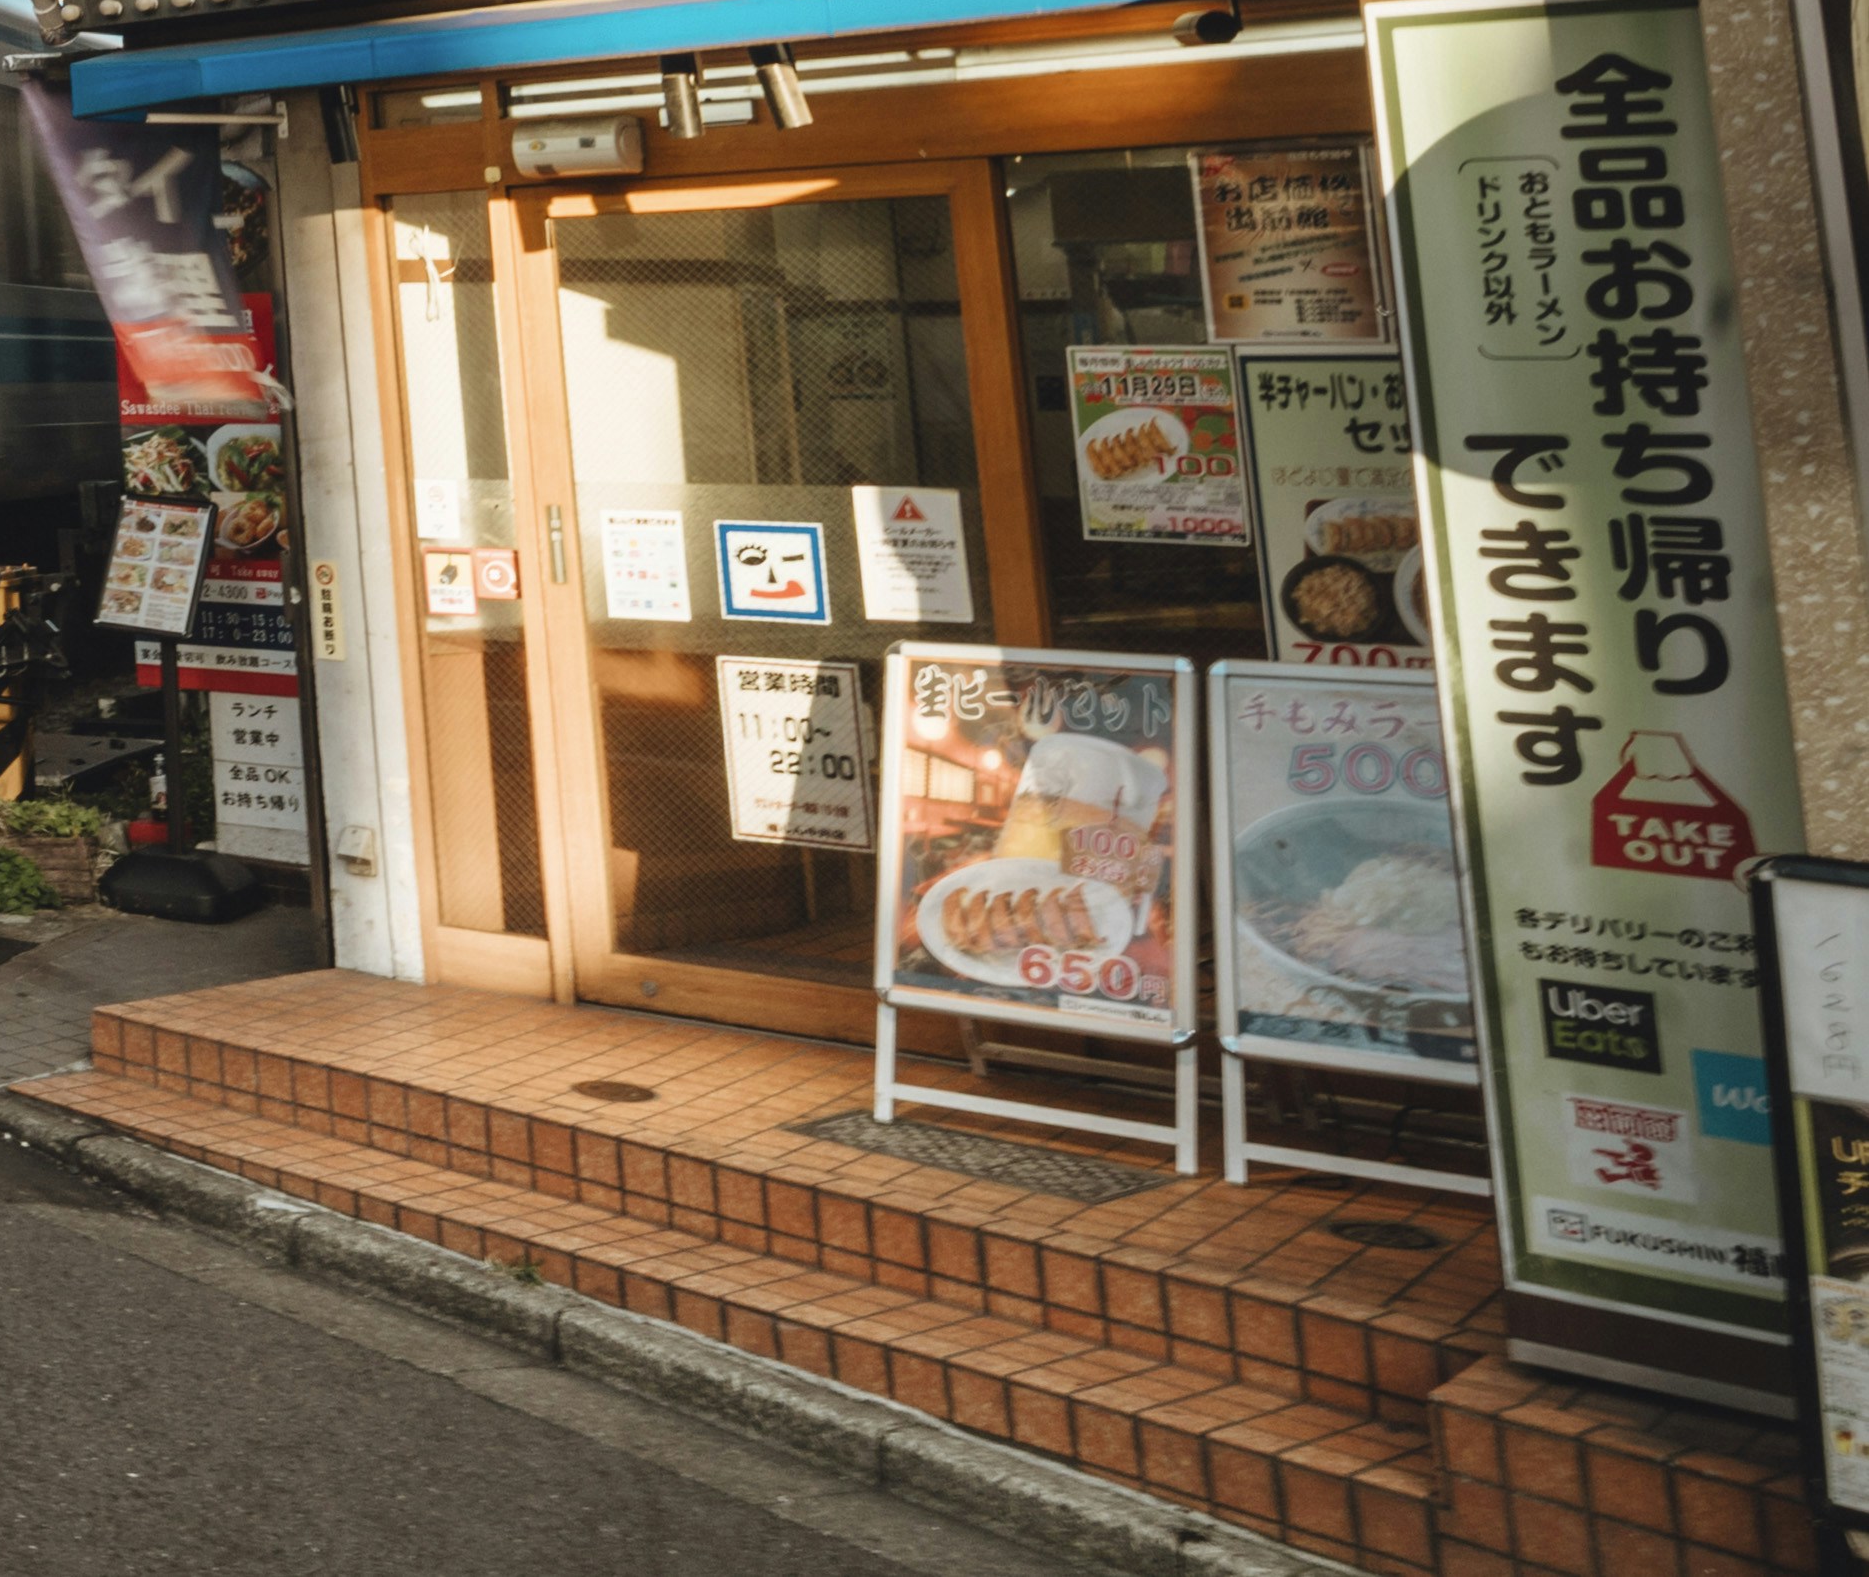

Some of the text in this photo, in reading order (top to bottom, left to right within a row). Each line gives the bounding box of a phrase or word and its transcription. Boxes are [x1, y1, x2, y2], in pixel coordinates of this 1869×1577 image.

[1476, 174, 1519, 326] ドリンク以外
[1518, 168, 1567, 348] おともラーメン
[1554, 52, 1732, 698] 全品お持ち帰り
[120, 399, 181, 416] Sawasdee
[1462, 430, 1603, 788] できます
[739, 669, 841, 699] 営業時間
[914, 663, 1172, 740] 生ビールセット
[231, 702, 279, 721] ランチ
[231, 728, 281, 748] 営業中
[228, 765, 292, 784] 全品 OK
[769, 749, 855, 781] 22:00
[221, 790, 300, 813] お持ち帰り
[1607, 812, 1738, 848] TAKE
[1621, 839, 1729, 872] OUT
[1547, 984, 1647, 1027] Uber
[1552, 1020, 1651, 1061] Eats
[1589, 1224, 1730, 1265] FUKUSHIN
